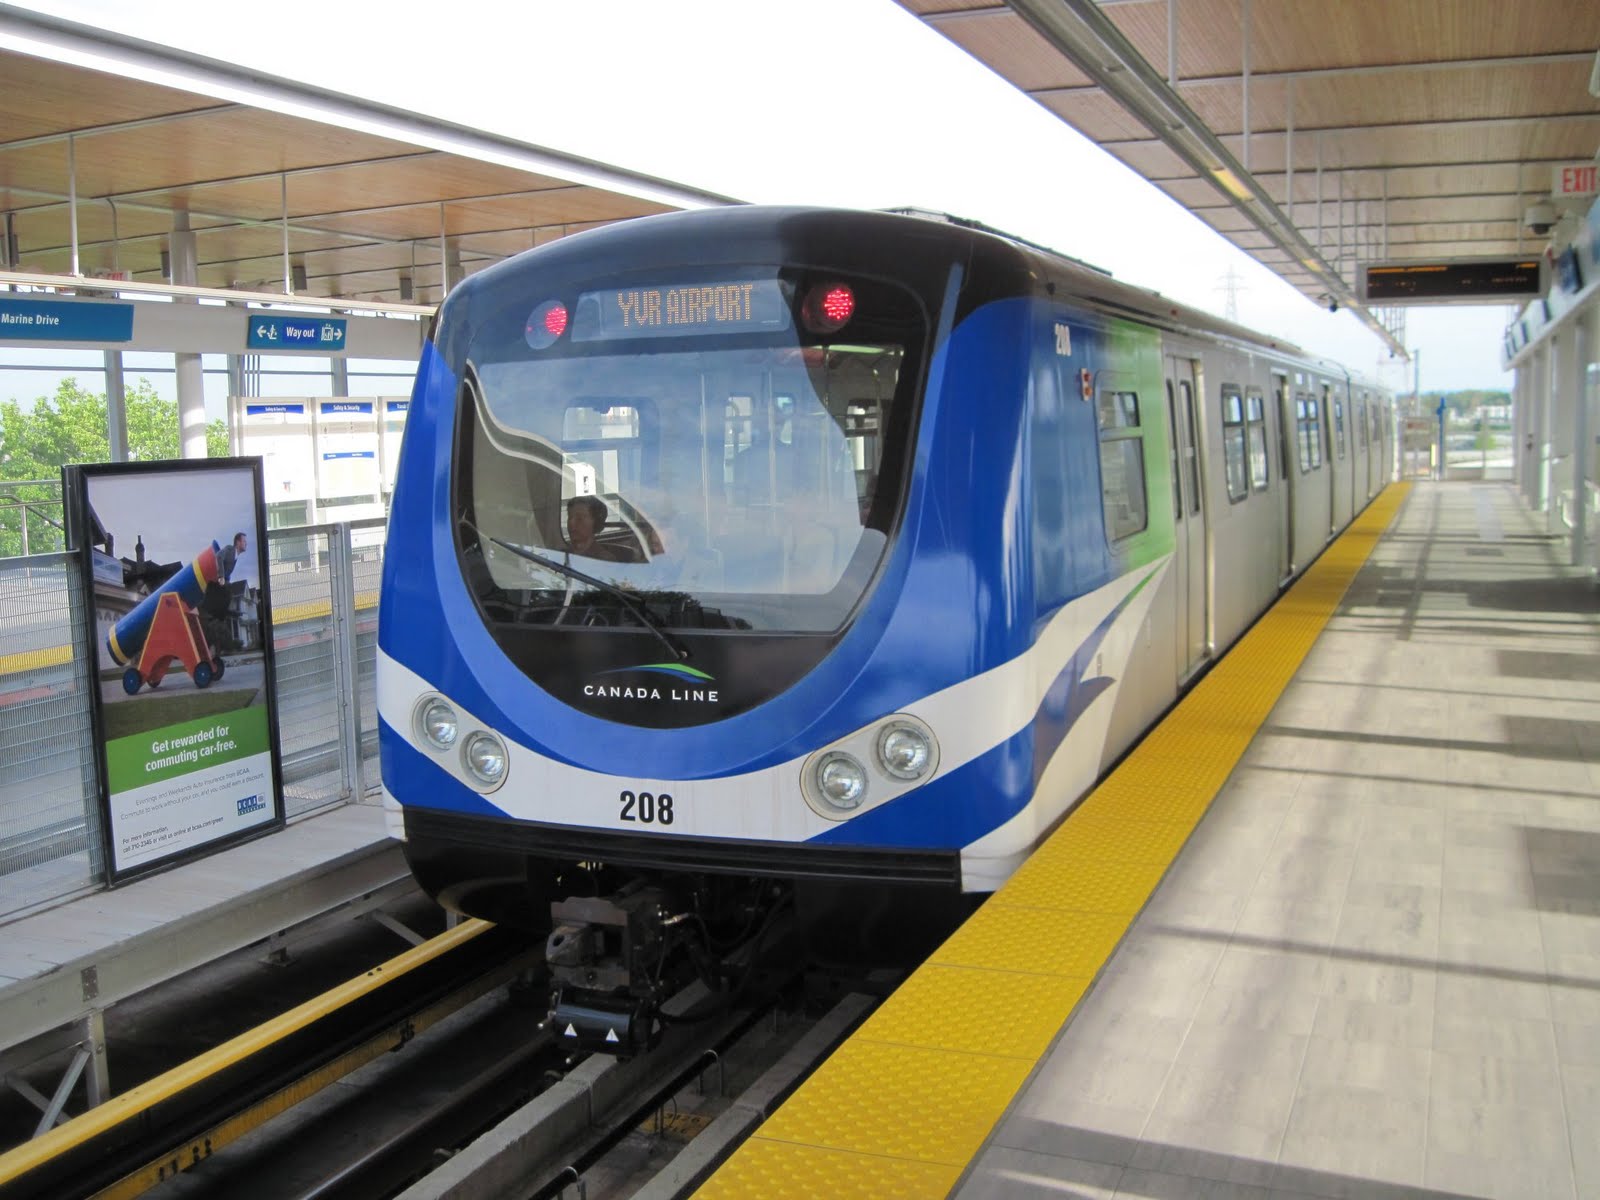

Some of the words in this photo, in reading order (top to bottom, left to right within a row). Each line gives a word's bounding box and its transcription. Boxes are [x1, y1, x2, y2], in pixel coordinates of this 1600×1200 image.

[1563, 167, 1597, 193] EXIT
[617, 289, 661, 327] YVR
[667, 284, 753, 324] AIRPORT
[1, 313, 33, 324] Marine
[36, 314, 60, 326] Drive
[286, 326, 301, 340] Way
[303, 328, 315, 338] out
[584, 685, 661, 699] CANADA
[672, 689, 719, 702] LINE
[152, 739, 169, 754] Get
[171, 727, 214, 750] rewarded
[216, 725, 229, 738] for
[145, 750, 198, 772] commuting
[200, 740, 237, 757] car-free.
[619, 790, 674, 825] 208
[131, 833, 142, 842] more
